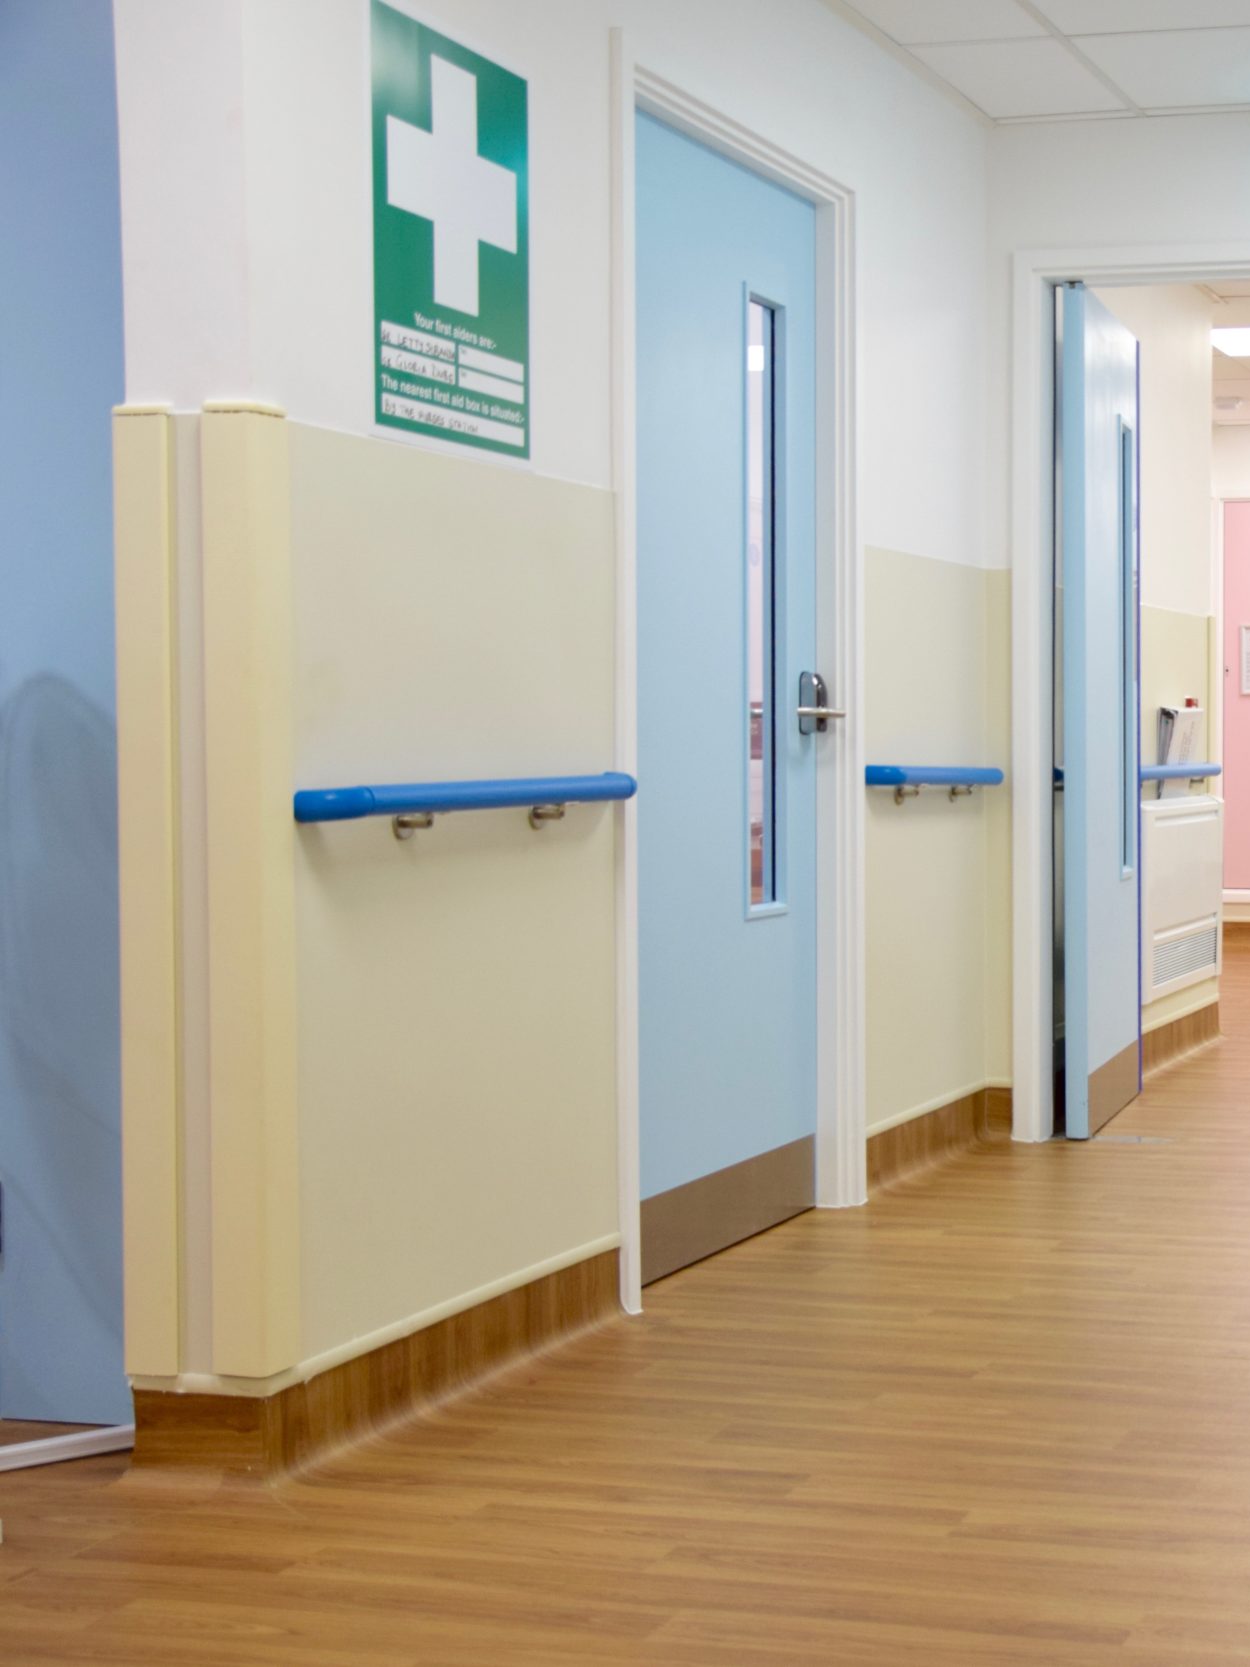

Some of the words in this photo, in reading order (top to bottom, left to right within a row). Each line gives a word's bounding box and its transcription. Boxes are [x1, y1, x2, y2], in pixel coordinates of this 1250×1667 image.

[414, 312, 433, 329] Your
[435, 319, 451, 336] first
[453, 327, 477, 344] aiders
[382, 374, 398, 390] The
[400, 382, 432, 400] nearest
[434, 389, 450, 405] first
[451, 393, 465, 409] aid
[466, 397, 480, 412] box
[481, 401, 489, 415] is
